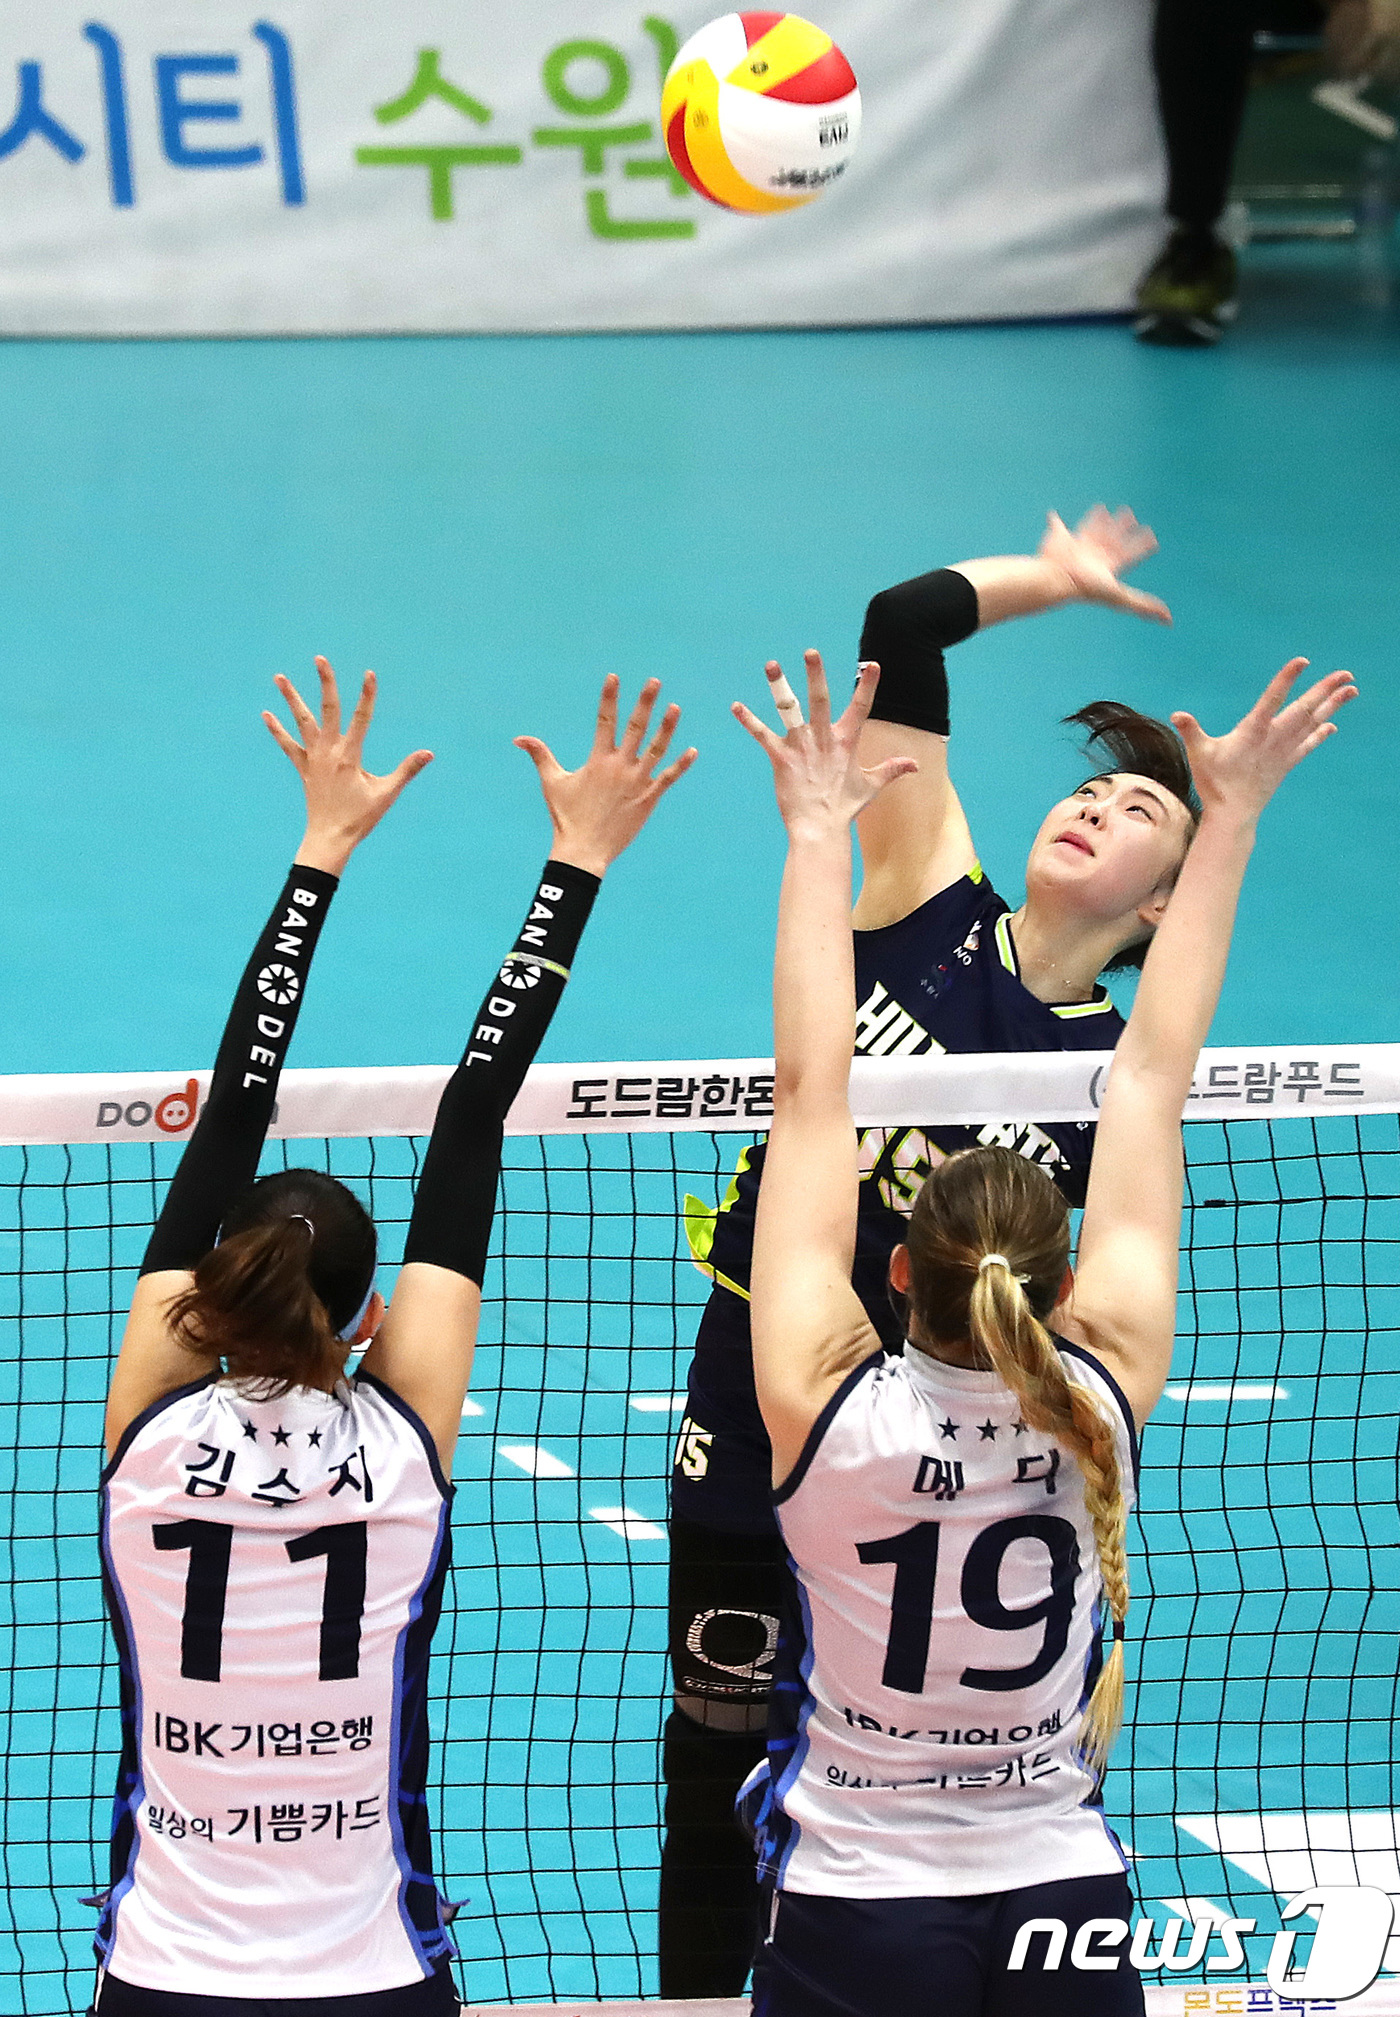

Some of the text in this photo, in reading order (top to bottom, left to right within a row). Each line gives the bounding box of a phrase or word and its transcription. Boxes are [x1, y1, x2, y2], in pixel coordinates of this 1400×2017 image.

[353, 15, 697, 241] 수원
[566, 1074, 776, 1118] 도드람한돈
[151, 1518, 368, 1683] 11
[854, 1513, 1082, 1696] 19
[147, 1796, 382, 1844] 일상의 기쁨카드
